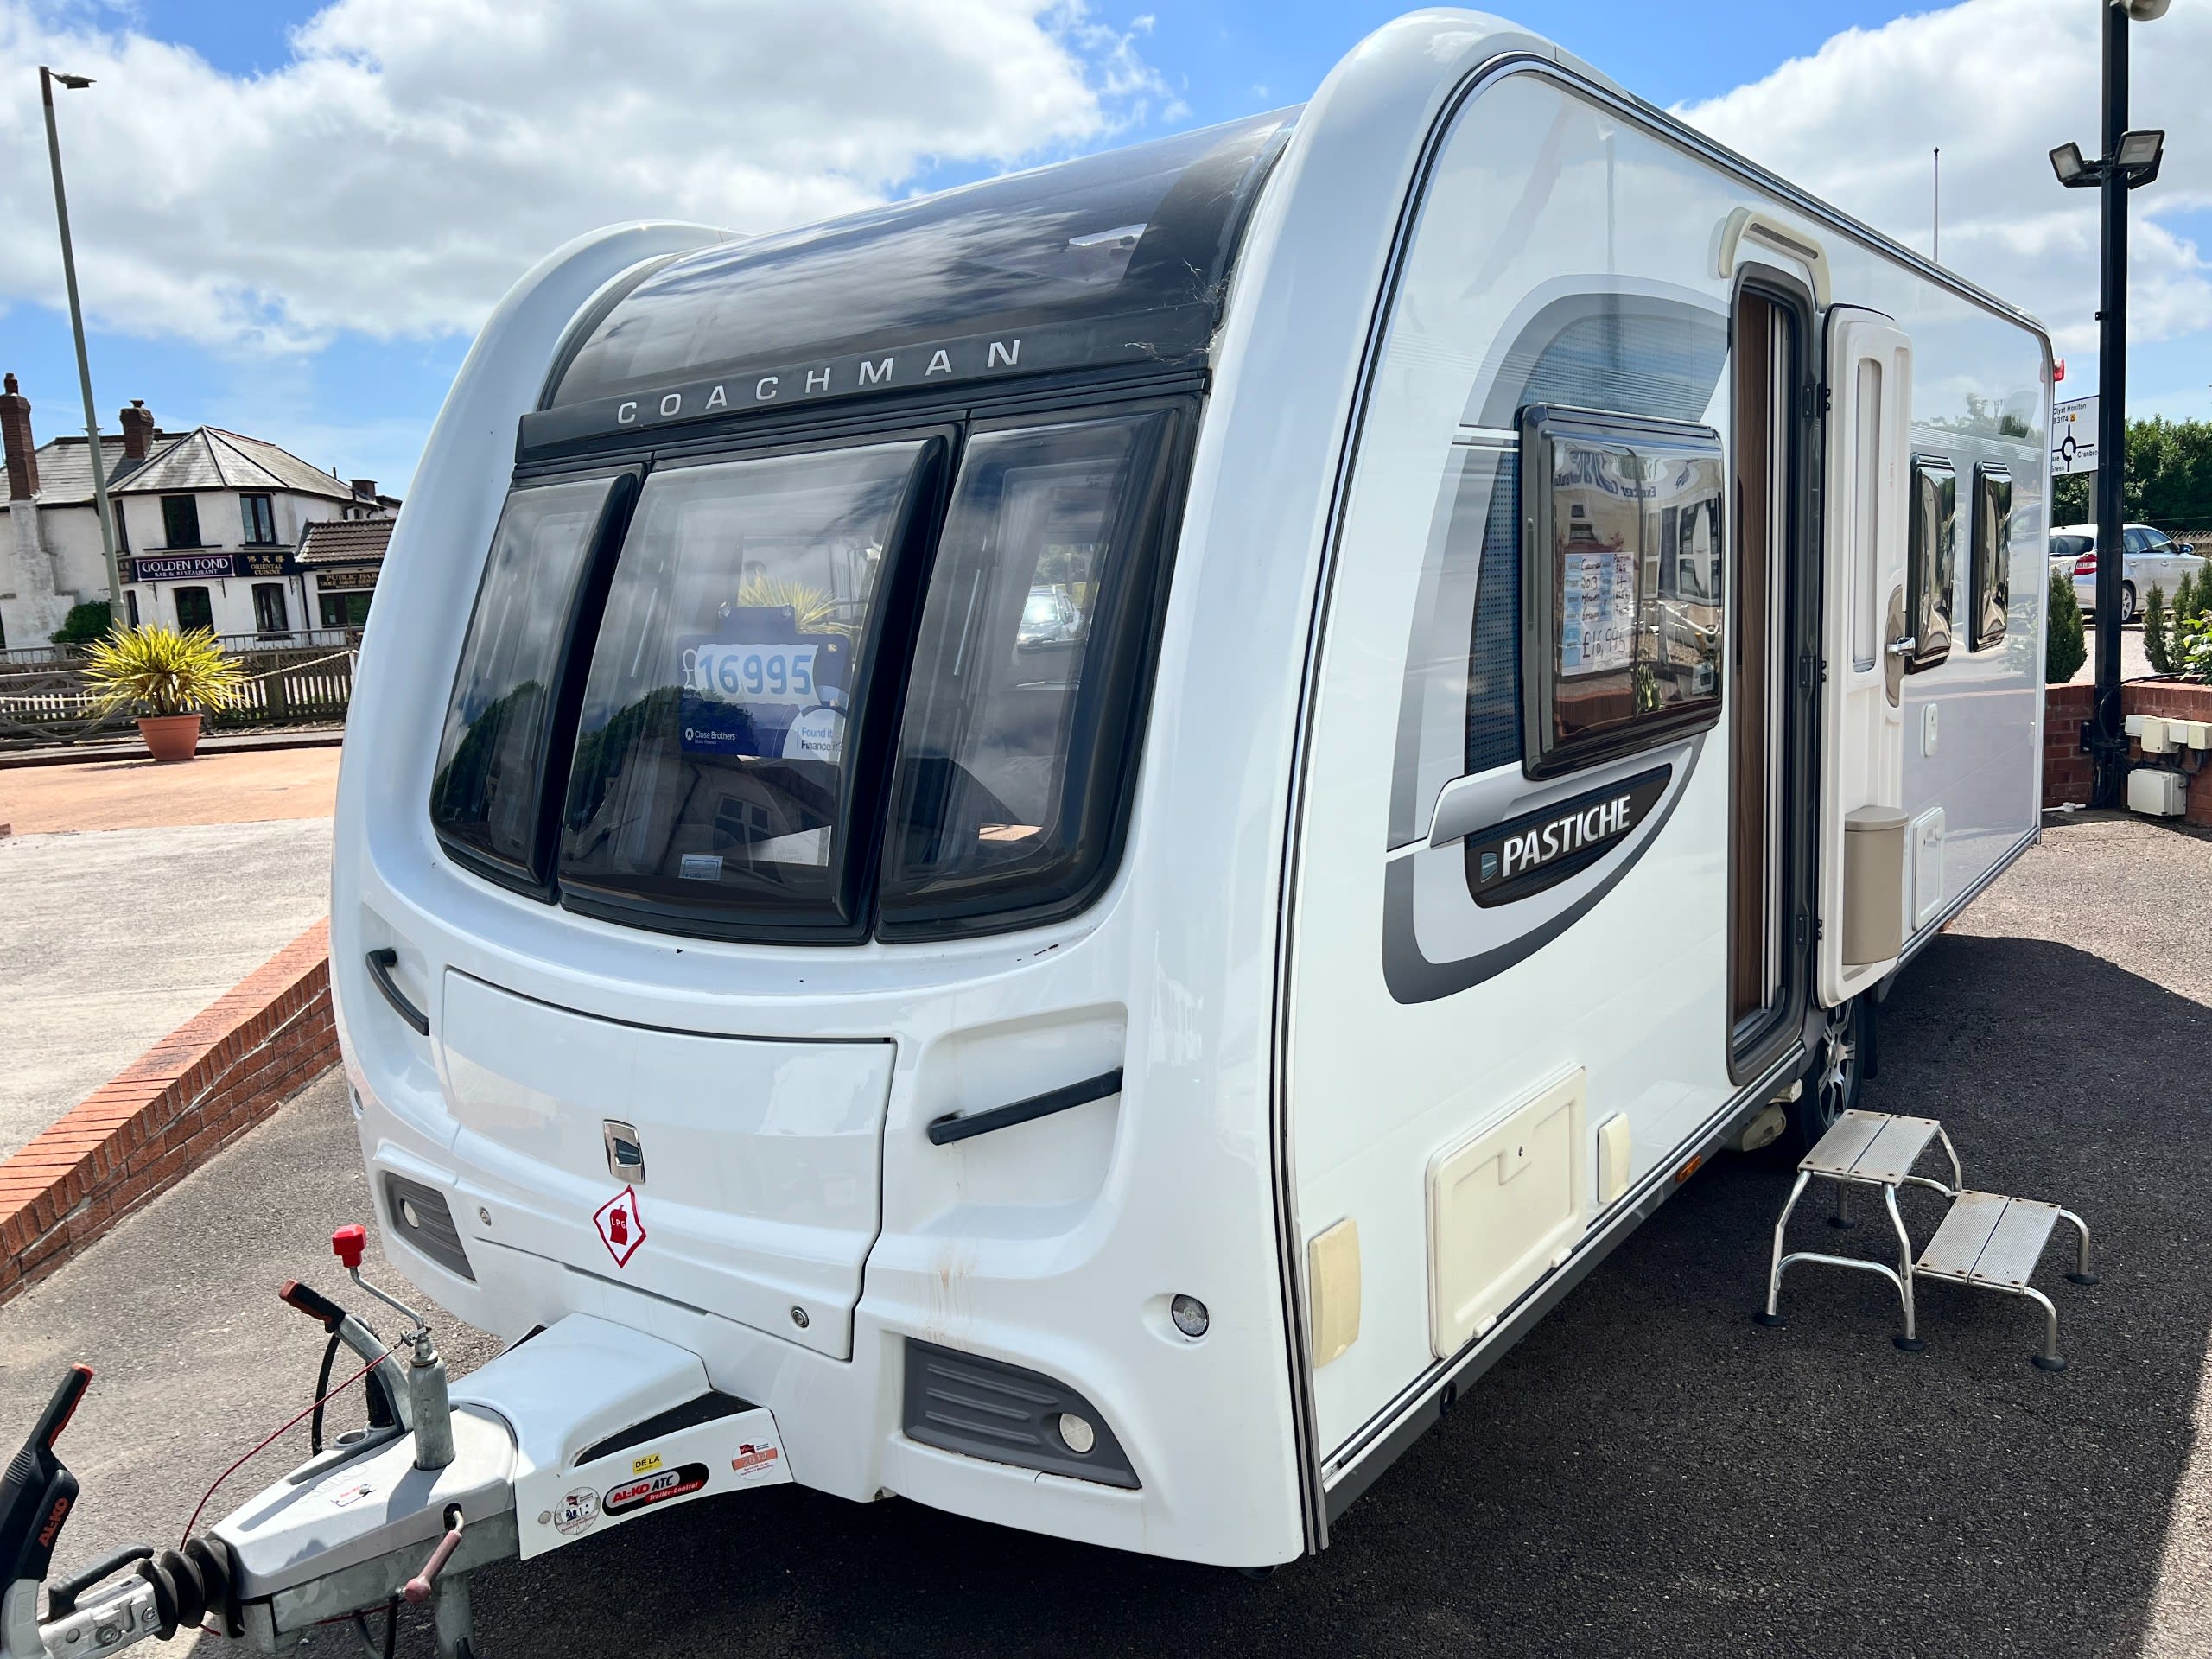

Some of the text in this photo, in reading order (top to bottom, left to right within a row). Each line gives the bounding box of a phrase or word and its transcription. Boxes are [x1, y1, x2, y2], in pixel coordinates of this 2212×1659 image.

[617, 339, 1021, 424] COACHMAN
[2053, 403, 2087, 415] Clyst Honiton
[2077, 449, 2098, 459] Cranbro
[142, 560, 191, 573] GOLDEN
[195, 558, 228, 569] POND
[695, 730, 736, 741] Close Brothers
[802, 727, 833, 738] Found it
[802, 740, 831, 752] Finance
[1502, 793, 1631, 879] PASTICHE
[611, 1217, 626, 1229] LPG
[635, 1459, 647, 1468] DE
[649, 1455, 660, 1464] LA
[744, 1452, 767, 1466] 2014
[612, 1483, 651, 1503] AL-KO
[652, 1474, 674, 1491] ATC
[649, 1482, 698, 1501] Trailer-Control
[38, 1497, 71, 1548] AL-KO
